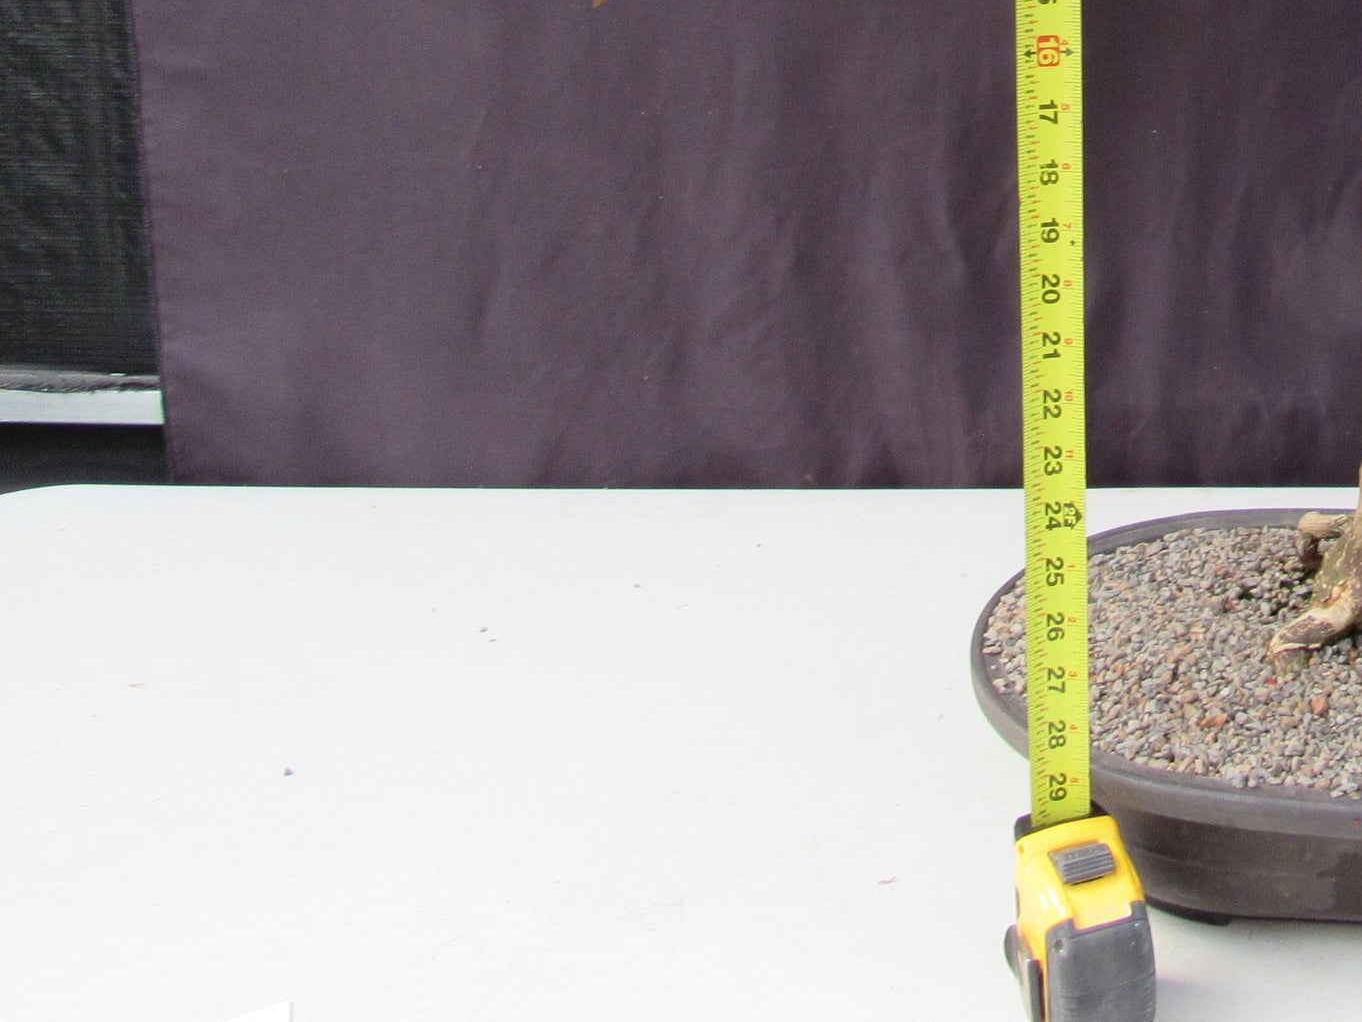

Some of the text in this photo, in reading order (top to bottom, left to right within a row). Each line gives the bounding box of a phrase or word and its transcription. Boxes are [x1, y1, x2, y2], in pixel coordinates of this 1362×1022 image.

[1038, 38, 1059, 65] 16
[1039, 99, 1058, 125] 17
[1040, 159, 1059, 186] 18
[1041, 218, 1059, 244] 19
[1041, 274, 1060, 304] 20
[1042, 332, 1061, 359] 21
[1043, 389, 1062, 420] 22
[1064, 391, 1074, 402] 10
[1044, 446, 1062, 476] 23
[1045, 501, 1062, 531] 24
[1046, 557, 1064, 587] 25
[1046, 612, 1065, 641] 26
[1047, 666, 1066, 694] 27
[1048, 720, 1066, 749] 28
[1049, 772, 1067, 801] 29
